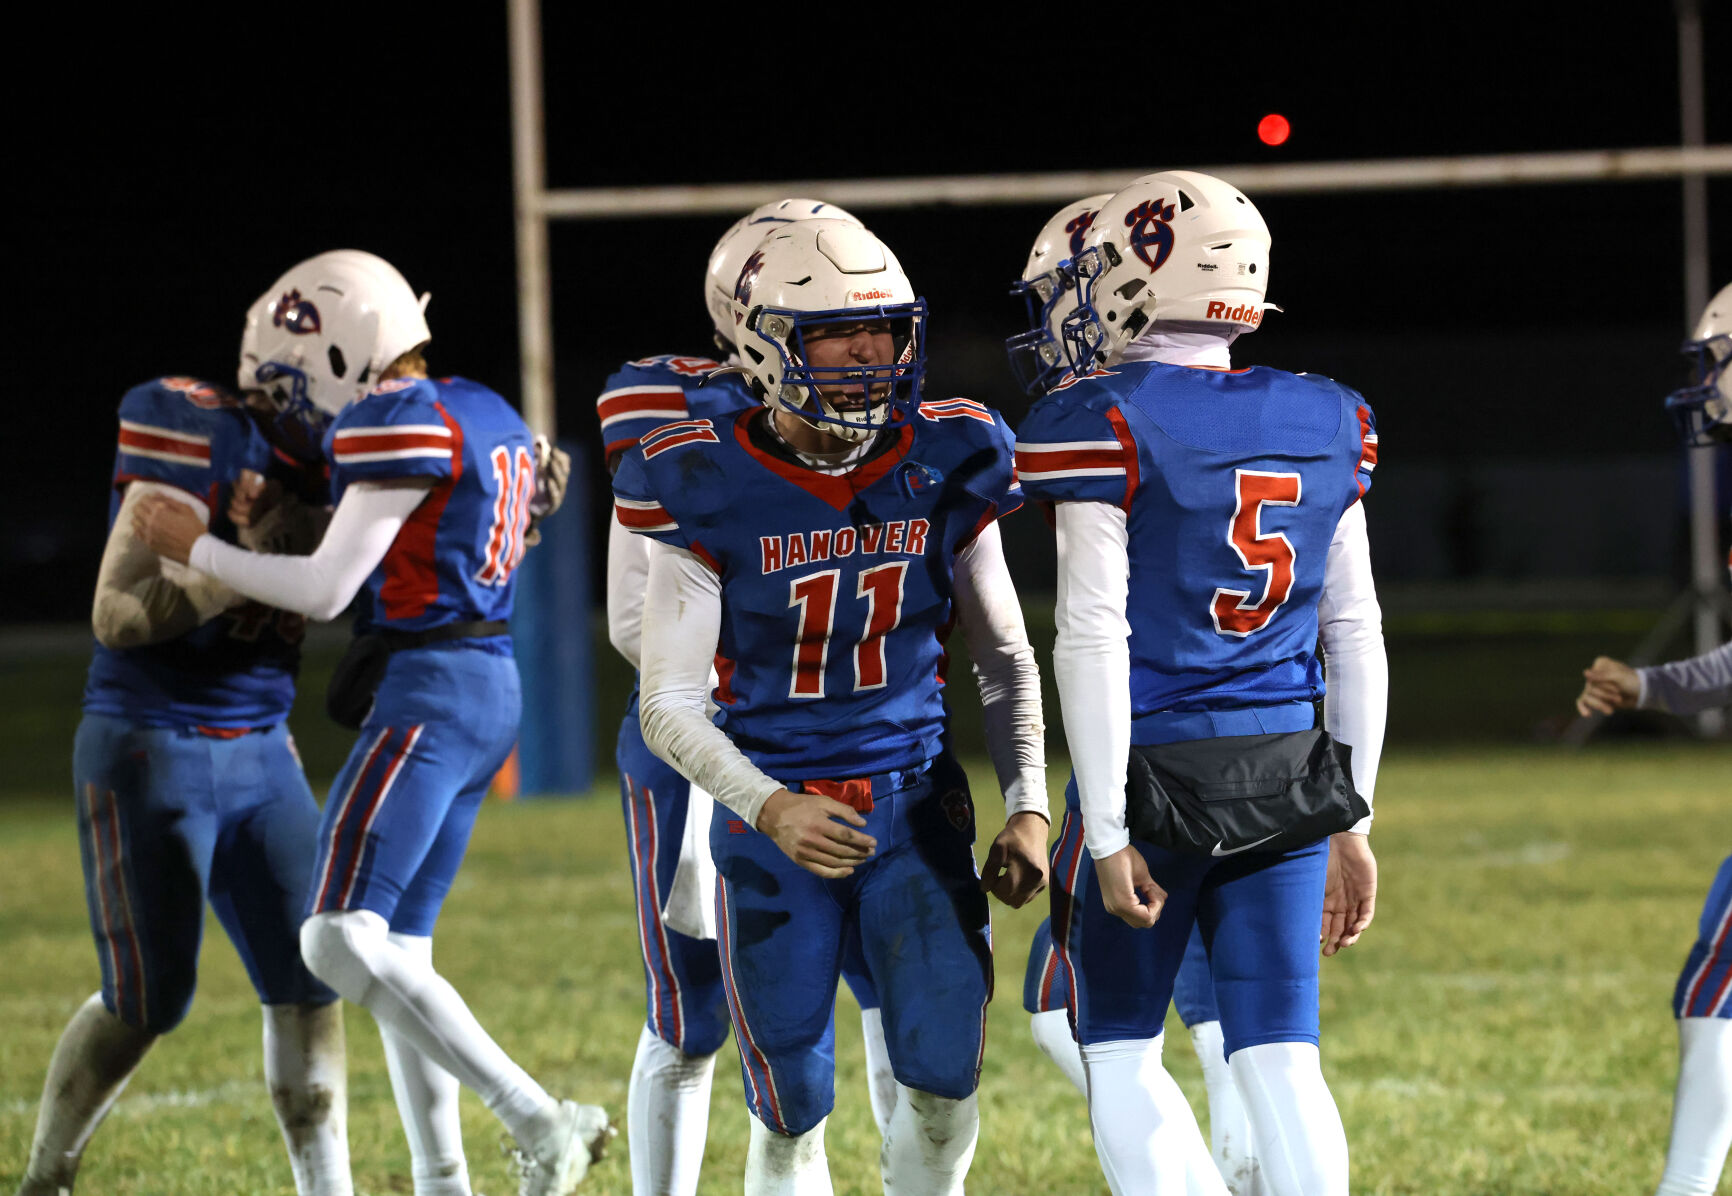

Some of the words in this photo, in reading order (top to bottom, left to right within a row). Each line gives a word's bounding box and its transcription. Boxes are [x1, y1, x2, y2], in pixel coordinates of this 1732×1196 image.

[853, 288, 893, 301] Riddell
[473, 445, 536, 587] 10
[760, 517, 931, 575] HANOVER
[1209, 468, 1302, 638] 5
[788, 560, 910, 699] 11
